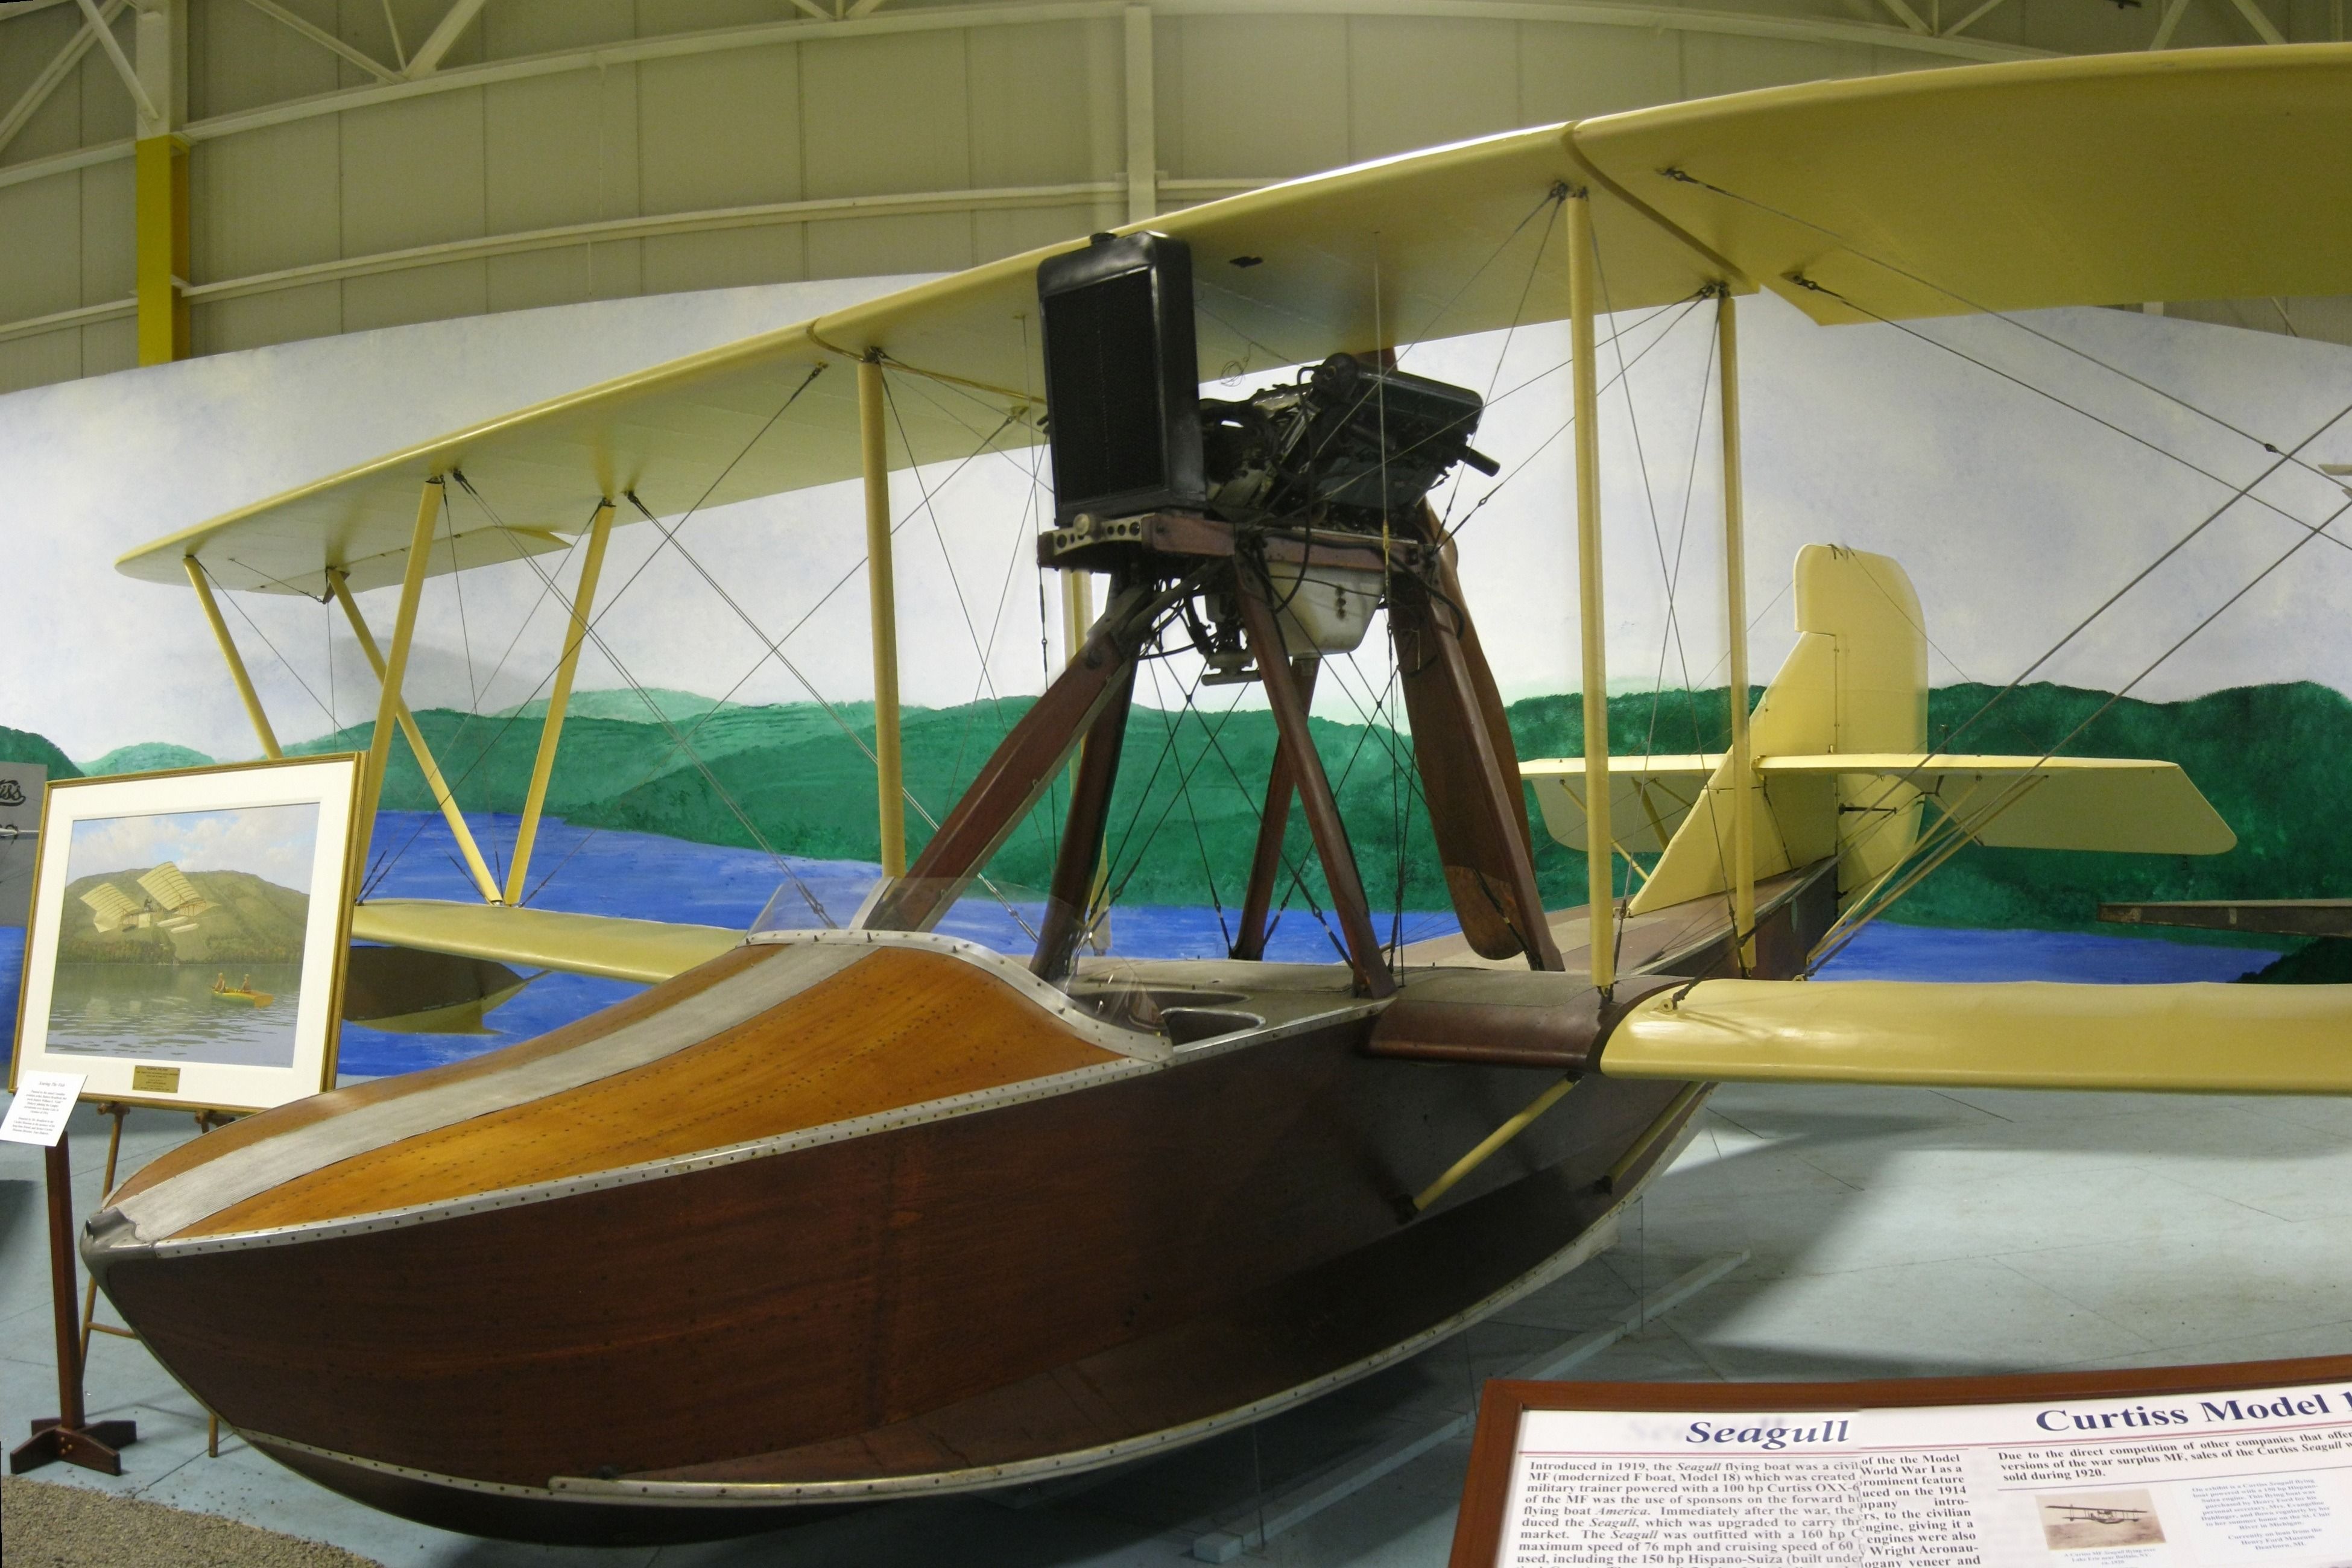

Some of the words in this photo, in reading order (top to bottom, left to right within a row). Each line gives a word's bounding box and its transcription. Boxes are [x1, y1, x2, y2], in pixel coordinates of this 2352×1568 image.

[2036, 1406, 2189, 1431] Curtiss
[2198, 1394, 2332, 1422] Model
[1686, 1420, 1849, 1450] Seagull
[1998, 1452, 2022, 1461] Due
[2045, 1450, 2064, 1458] the
[2070, 1448, 2104, 1457] direct
[2109, 1444, 2178, 1456] competition
[2183, 1441, 2195, 1450] of
[2200, 1440, 2230, 1449] other
[2236, 1435, 2295, 1447] companies
[2299, 1434, 2322, 1442] that
[1861, 1456, 1873, 1465] of
[1877, 1456, 1896, 1465] the
[1900, 1455, 1918, 1464] the
[1922, 1453, 1960, 1463] Model
[2000, 1461, 2050, 1471] versions
[2053, 1459, 2065, 1468] of
[2068, 1459, 2087, 1467] the
[2117, 1453, 2161, 1466] surplus
[2163, 1453, 2188, 1462] MF,
[2190, 1451, 2218, 1460] sales
[2221, 1449, 2233, 1458] of
[2236, 1448, 2254, 1457] the
[2257, 1445, 2299, 1455] Curtiss
[2301, 1441, 2342, 1452] Seagull
[1530, 1461, 1597, 1470] Introduced
[1601, 1462, 1613, 1470] in
[1619, 1462, 1649, 1472] 1919,
[1654, 1462, 1672, 1471] the
[1676, 1462, 1722, 1473] Seagull
[1725, 1462, 1759, 1473] flying
[1764, 1462, 1791, 1471] boat
[1860, 1465, 1898, 1476] World
[1901, 1465, 1927, 1475] War
[1930, 1465, 1936, 1474] I
[1529, 1472, 1551, 1481] MF
[1553, 1473, 1630, 1482] (modernized
[1634, 1473, 1643, 1482] F
[1645, 1473, 1675, 1482] boat,
[1680, 1473, 1718, 1482] Model
[1723, 1472, 1740, 1482] 18)
[1744, 1471, 1780, 1482] which
[1810, 1472, 1856, 1481] created
[1921, 1476, 1964, 1485] feature
[2003, 1472, 2028, 1482] sold
[2031, 1470, 2072, 1481] during
[2075, 1468, 2106, 1478] 1920.
[1527, 1483, 1575, 1494] military
[1579, 1484, 1623, 1493] trainer
[1625, 1484, 1678, 1495] powered
[1681, 1484, 1709, 1493] with
[1724, 1484, 1744, 1493] 100
[1748, 1484, 1764, 1495] hp
[1766, 1484, 1812, 1493] Curtiss
[1914, 1487, 1934, 1496] the
[1939, 1485, 1967, 1495] 1914
[1525, 1494, 1537, 1503] of
[1542, 1494, 1561, 1504] the
[1566, 1494, 1589, 1504] MF
[1620, 1495, 1640, 1504] the
[1669, 1495, 1681, 1504] of
[1686, 1497, 1743, 1506] sponsons
[1768, 1495, 1787, 1503] the
[1792, 1494, 1842, 1503] forward
[1934, 1497, 1969, 1506] intro-
[1524, 1506, 1559, 1517] flying
[1564, 1506, 1591, 1516] boat
[1661, 1506, 1738, 1518] Immediately
[1744, 1506, 1775, 1515] after
[1778, 1506, 1798, 1515] the
[1835, 1505, 1854, 1514] the
[1884, 1511, 1897, 1520] to
[1902, 1510, 1921, 1519] the
[1926, 1508, 1971, 1518] civilian
[1522, 1517, 1560, 1527] duced
[1565, 1518, 1584, 1527] the
[1589, 1517, 1639, 1529] Seagull,
[1645, 1518, 1683, 1528] which
[1718, 1517, 1778, 1529] upgraded
[1802, 1520, 1835, 1529] carry
[1908, 1520, 1947, 1533] giving
[1952, 1519, 1961, 1529] it
[1520, 1529, 1569, 1539] market.
[1581, 1529, 1605, 1539] The
[1610, 1529, 1658, 1541] Seagull
[1693, 1529, 1748, 1539] outfitted
[1754, 1529, 1781, 1539] with
[1802, 1529, 1823, 1539] 160
[1829, 1529, 1845, 1541] hp
[1867, 1532, 1914, 1546] engines
[1952, 1531, 1976, 1541] also
[1519, 1541, 1583, 1551] maximum
[1587, 1541, 1623, 1554] speed
[1627, 1541, 1640, 1551] of
[1645, 1541, 1659, 1551] 76
[1663, 1542, 1692, 1554] mph
[1696, 1542, 1721, 1552] and
[1725, 1541, 1777, 1553] cruising
[1781, 1541, 1817, 1553] speed
[1821, 1541, 1835, 1551] of
[1838, 1541, 1853, 1550] 60
[1870, 1545, 1915, 1558] Wright
[1919, 1544, 1979, 1554] Aeronau-
[1517, 1554, 1549, 1564] used,
[1553, 1554, 1614, 1566] including
[1617, 1554, 1638, 1564] the
[1643, 1554, 1664, 1564] 150
[1668, 1554, 1684, 1566] hp
[1689, 1554, 1783, 1566] Hispano-Suiza
[1786, 1554, 1821, 1565] (built
[1908, 1558, 1951, 1567] veneer
[1957, 1555, 1981, 1566] and
